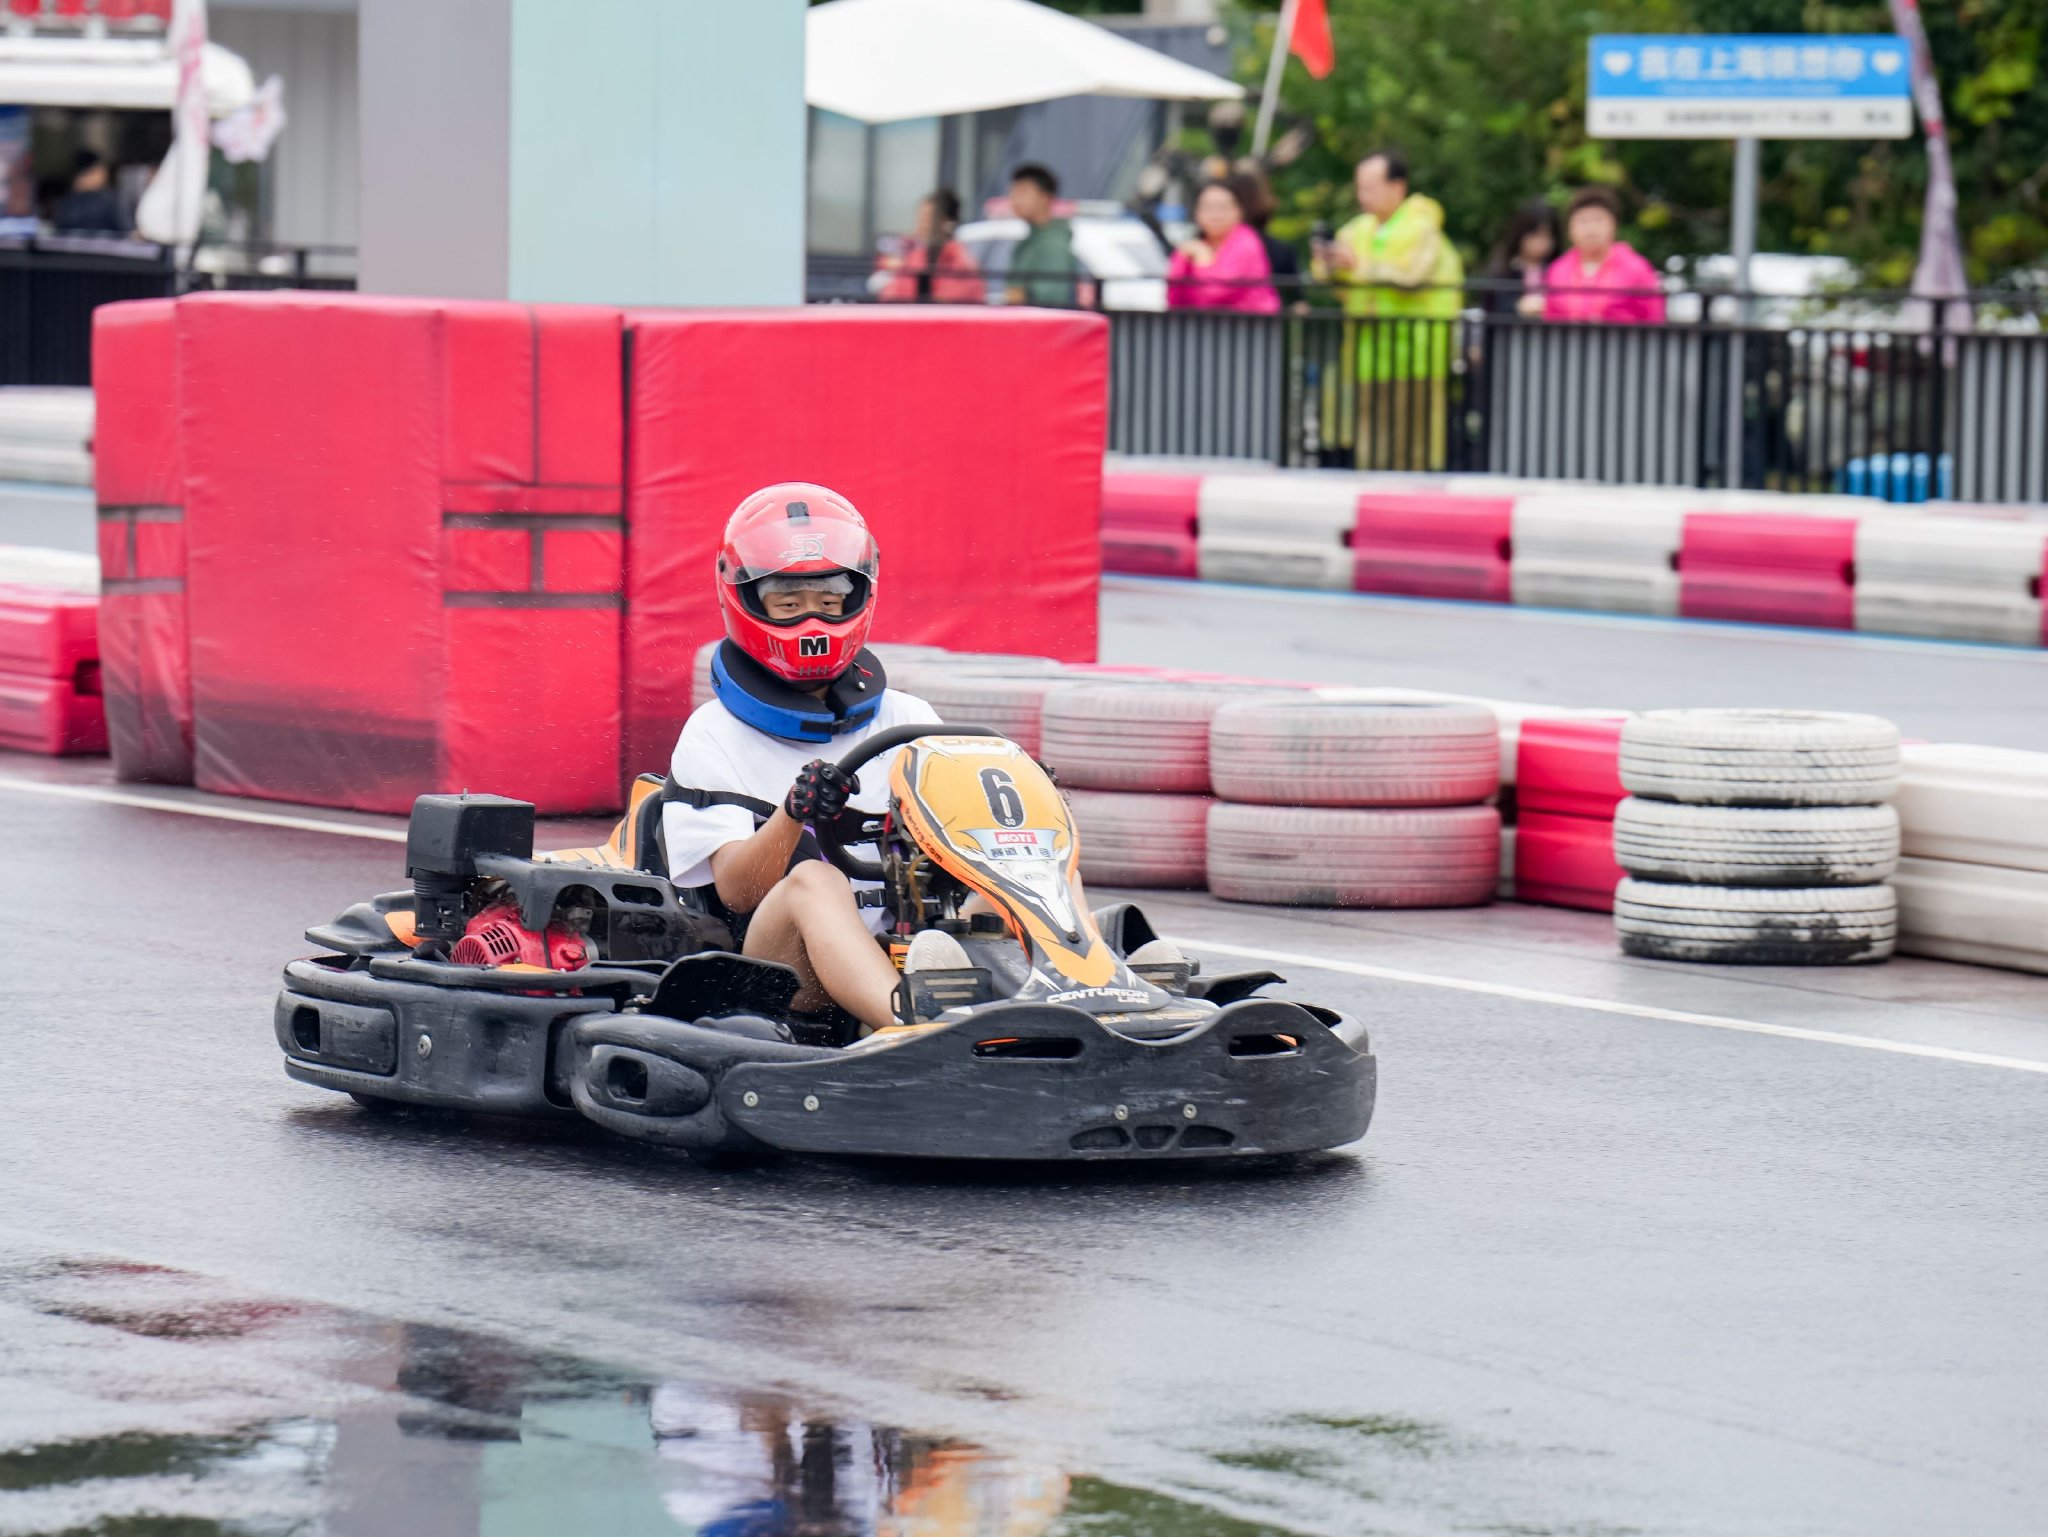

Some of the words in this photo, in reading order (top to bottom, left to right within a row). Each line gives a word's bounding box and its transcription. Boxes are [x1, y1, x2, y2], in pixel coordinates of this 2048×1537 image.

[800, 636, 828, 656] M
[979, 768, 1025, 828] 6
[1047, 987, 1149, 1004] CENTURION
